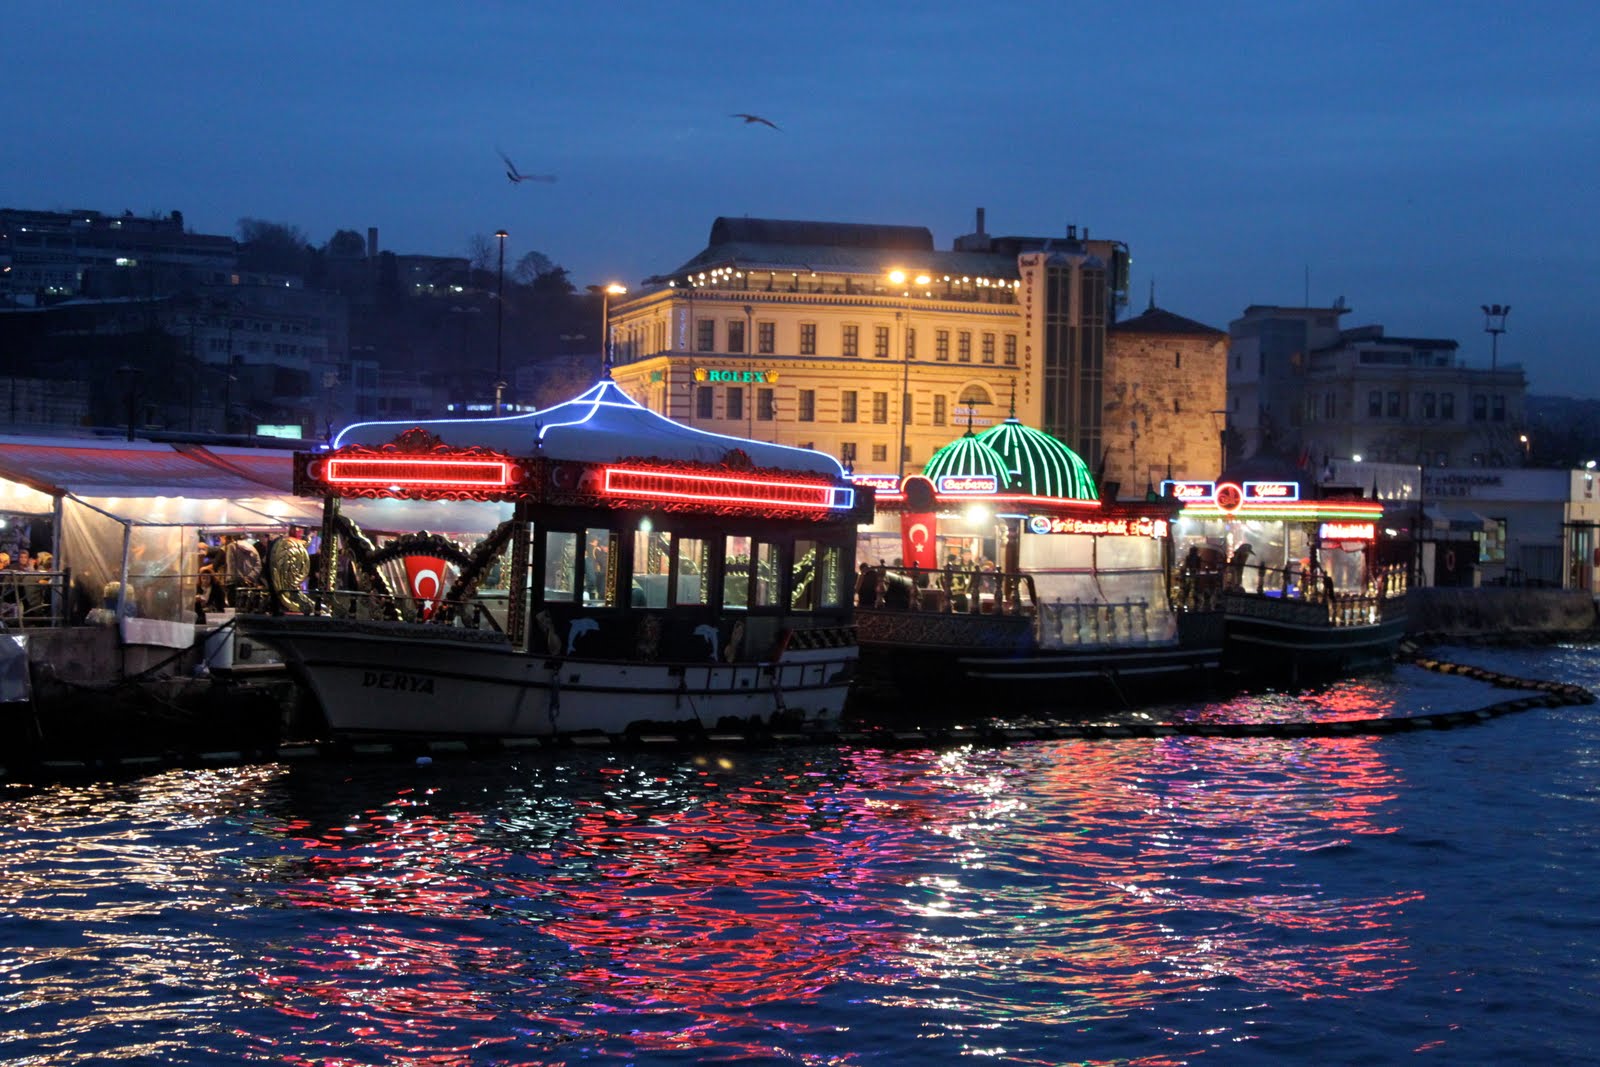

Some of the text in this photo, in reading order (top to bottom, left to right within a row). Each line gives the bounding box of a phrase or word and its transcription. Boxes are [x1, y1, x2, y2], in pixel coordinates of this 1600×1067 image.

[708, 370, 765, 383] ROLEX
[942, 479, 994, 491] Barbaros
[363, 672, 433, 695] DERYA
